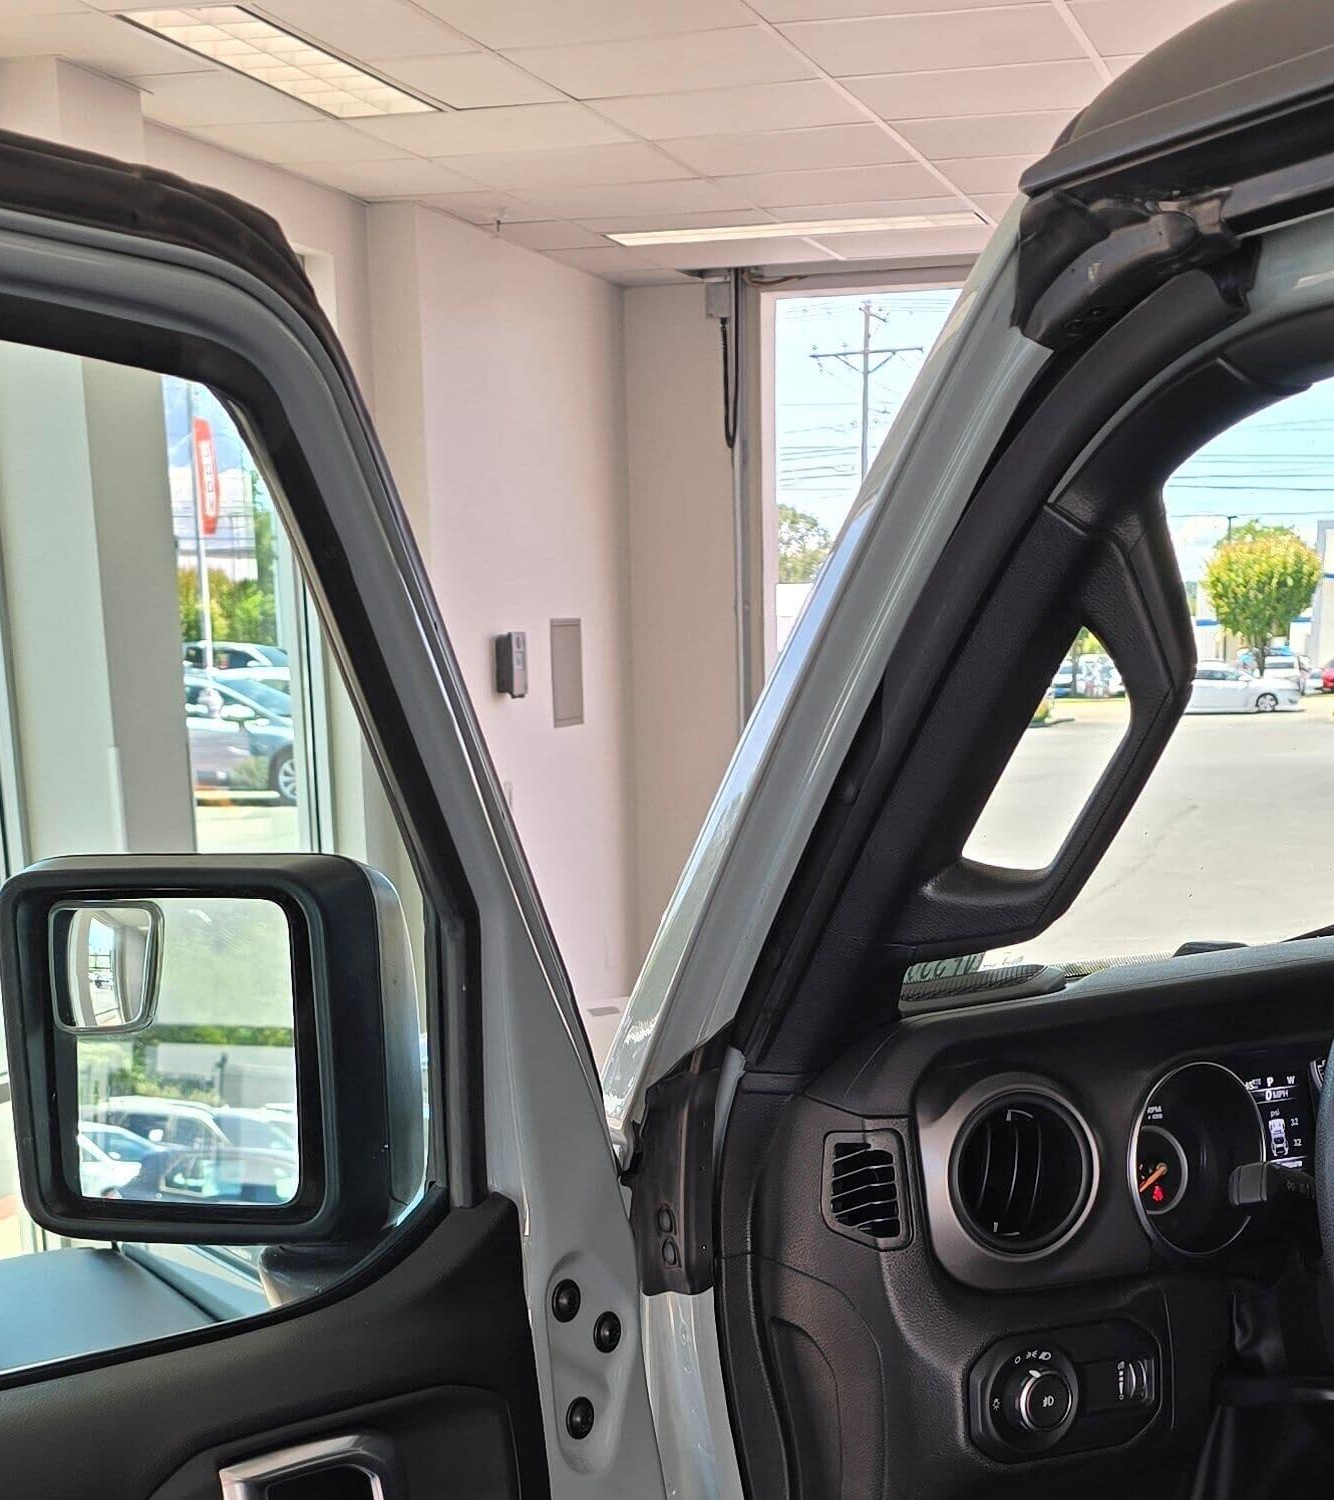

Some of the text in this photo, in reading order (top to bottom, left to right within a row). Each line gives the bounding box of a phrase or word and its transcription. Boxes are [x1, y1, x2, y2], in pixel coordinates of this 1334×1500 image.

[1266, 1076, 1274, 1087] P
[1286, 1075, 1296, 1085] W
[1265, 1090, 1289, 1101] 0 MPH
[1270, 1108, 1280, 1118] psi
[1290, 1117, 1299, 1126] 32
[1293, 1138, 1303, 1147] 32
